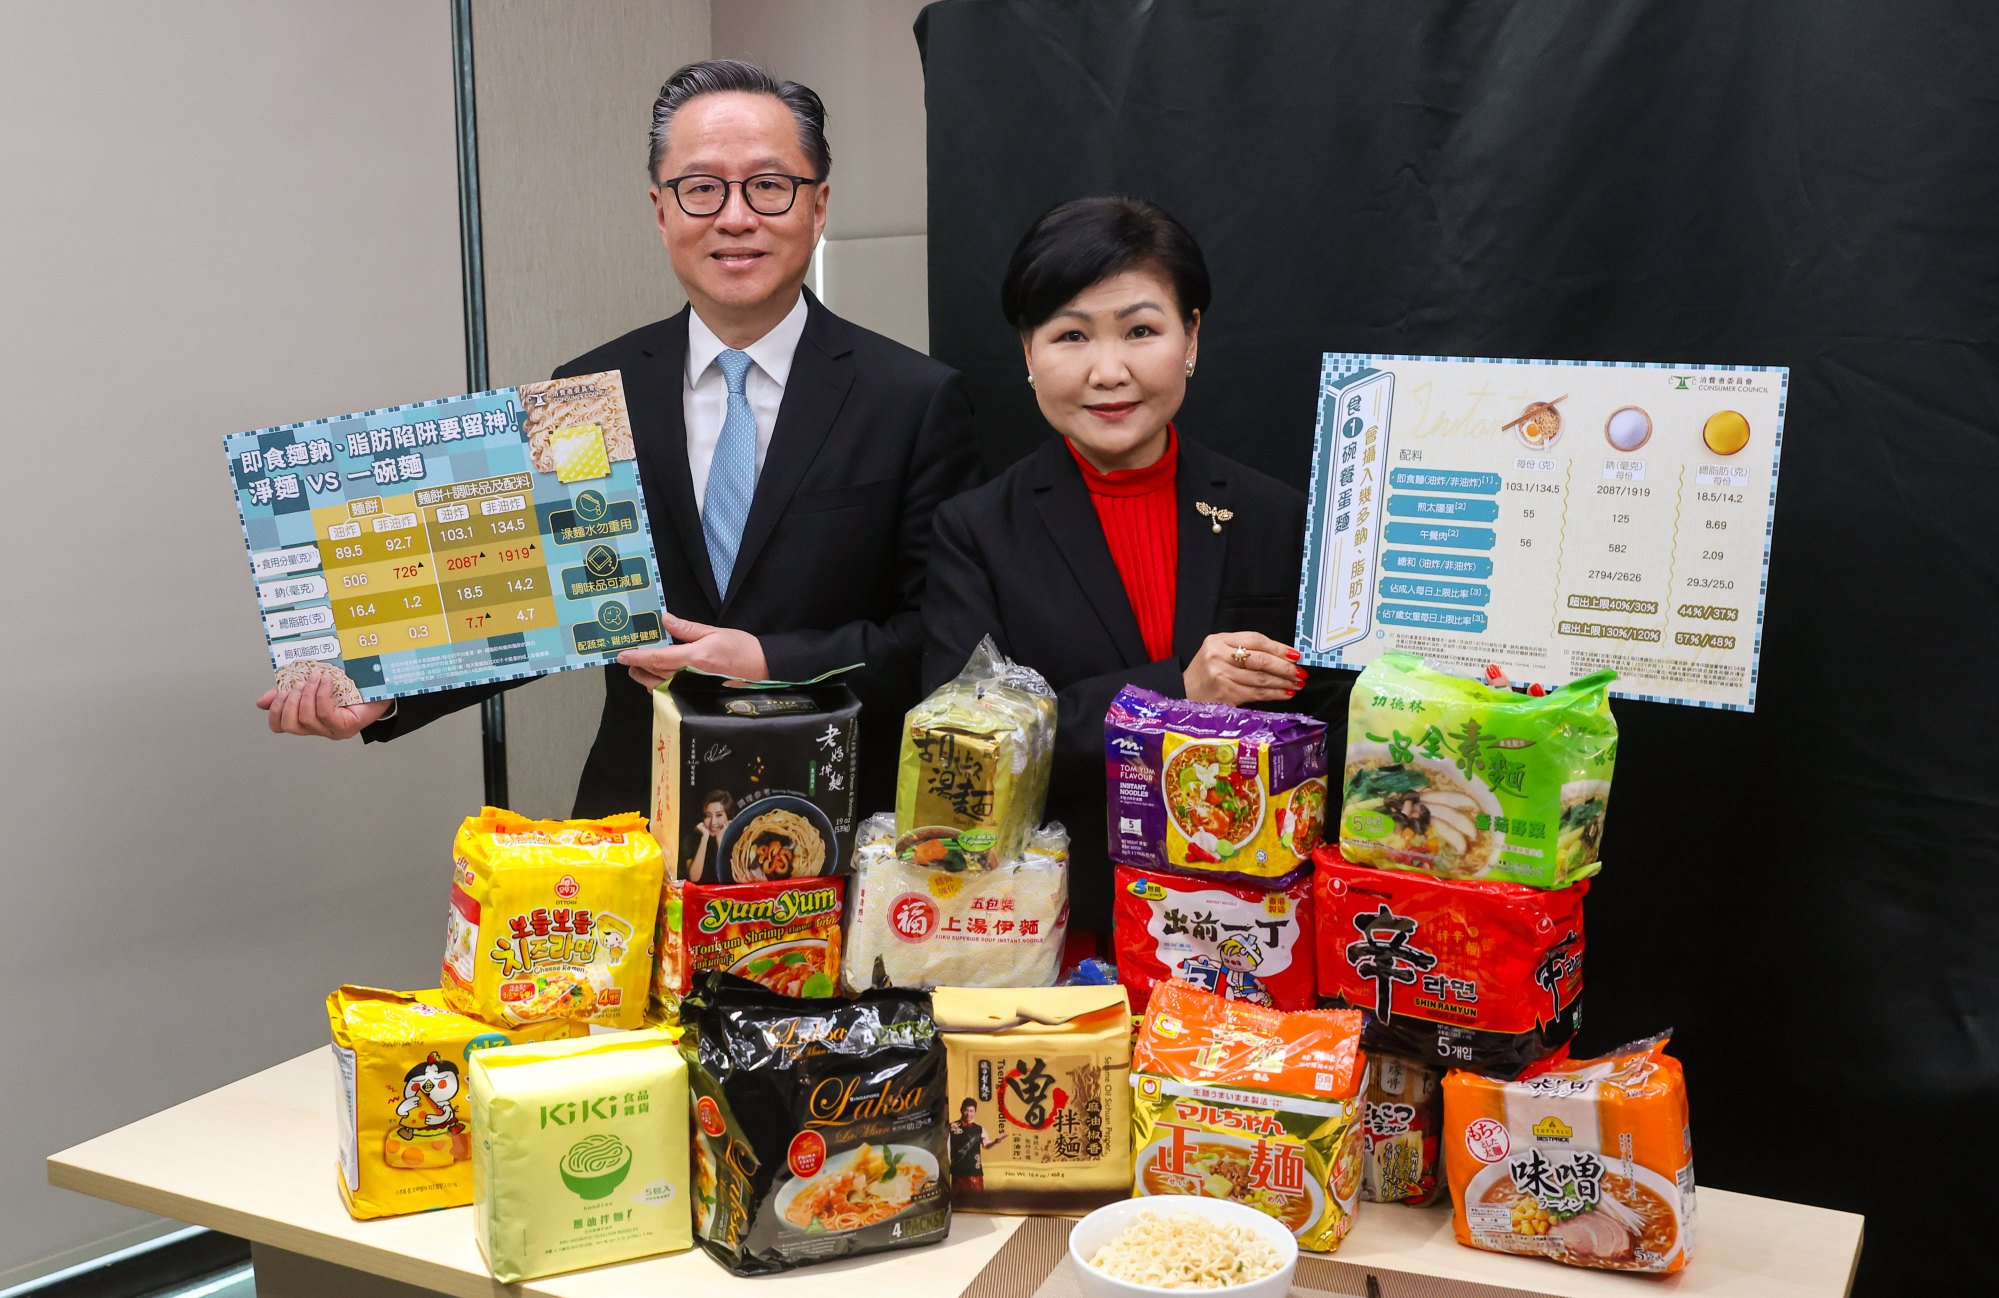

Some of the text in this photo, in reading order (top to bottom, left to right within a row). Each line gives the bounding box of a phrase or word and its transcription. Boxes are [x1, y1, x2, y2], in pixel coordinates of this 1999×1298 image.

[1399, 449, 1422, 461] 配料
[1606, 460, 1642, 471] 鈉(毫克)
[248, 454, 424, 504] 淨麵 VS 一碗麵
[1699, 466, 1748, 477] 總脂肪(克)
[417, 475, 531, 505] 麵餅+調味品及配料
[1506, 482, 1560, 494] 103.1/134.5
[1597, 485, 1651, 497] 2087/1919
[1697, 492, 1743, 503] 18.5/14.2
[333, 496, 521, 538] 油炸 非油炸 油炸 非油炸
[351, 499, 378, 515] 麵餅
[1523, 510, 1535, 518] 55
[1612, 515, 1630, 524] 125
[1705, 521, 1727, 530] 8.69
[335, 519, 525, 559] 89.5 92.7 103.1 134.5
[1520, 538, 1532, 547] 56
[1608, 544, 1627, 553] 582
[1702, 551, 1724, 560] 2.09
[274, 548, 530, 598] 鈉(毫克) 506 726 2087 1919
[1398, 557, 1416, 567] 總和
[1588, 570, 1642, 582] 2794/2626
[1687, 578, 1734, 589] 29.3/25.0
[571, 574, 643, 595] 調味品可減量
[279, 578, 534, 629] 總脂肪(克) 16.4 1.2 18.5 14.2
[1679, 605, 1702, 617] 44%
[1713, 608, 1737, 620] 37%
[284, 608, 534, 660] 飽和脂肪(克) 6.9 0.3 7.7 4.7
[1675, 633, 1699, 645] 57%
[1710, 636, 1735, 648] 48%
[1120, 765, 1155, 775] TOM YUM
[1120, 773, 1153, 782] FLAVOUR
[1120, 782, 1146, 791] INSTANT
[1120, 789, 1148, 798] NOODLES
[1129, 820, 1134, 829] 5
[971, 897, 1016, 911] 五包裝
[510, 908, 594, 939] 보들보들
[897, 902, 929, 935] 福
[941, 917, 1040, 936] 上湯伊麵
[1163, 908, 1290, 949] 出前一丁
[744, 926, 785, 945] Shrimp
[491, 934, 597, 977] 치즈라면
[1346, 903, 1436, 1026] 辛
[533, 965, 585, 974] Cheese Ramen
[1422, 976, 1478, 1002] 라면
[1415, 997, 1477, 1017] SHIN RAMYUN
[995, 1059, 1006, 1090] Tseng
[624, 1090, 649, 1103] 食品
[804, 1075, 925, 1128] Laksa
[849, 1092, 880, 1101] SINGAPORE
[1006, 1057, 1056, 1128] 曾
[1104, 1098, 1112, 1125] Sichuan
[1175, 1103, 1287, 1136] マルちゃん
[1053, 1109, 1081, 1158] 拌麵
[1086, 1101, 1102, 1155] 麻油椒香
[1169, 1176, 1186, 1186] せい
[1512, 1150, 1601, 1199] 味噌
[1538, 1199, 1584, 1210] ラーメン
[892, 1223, 903, 1238] 4
